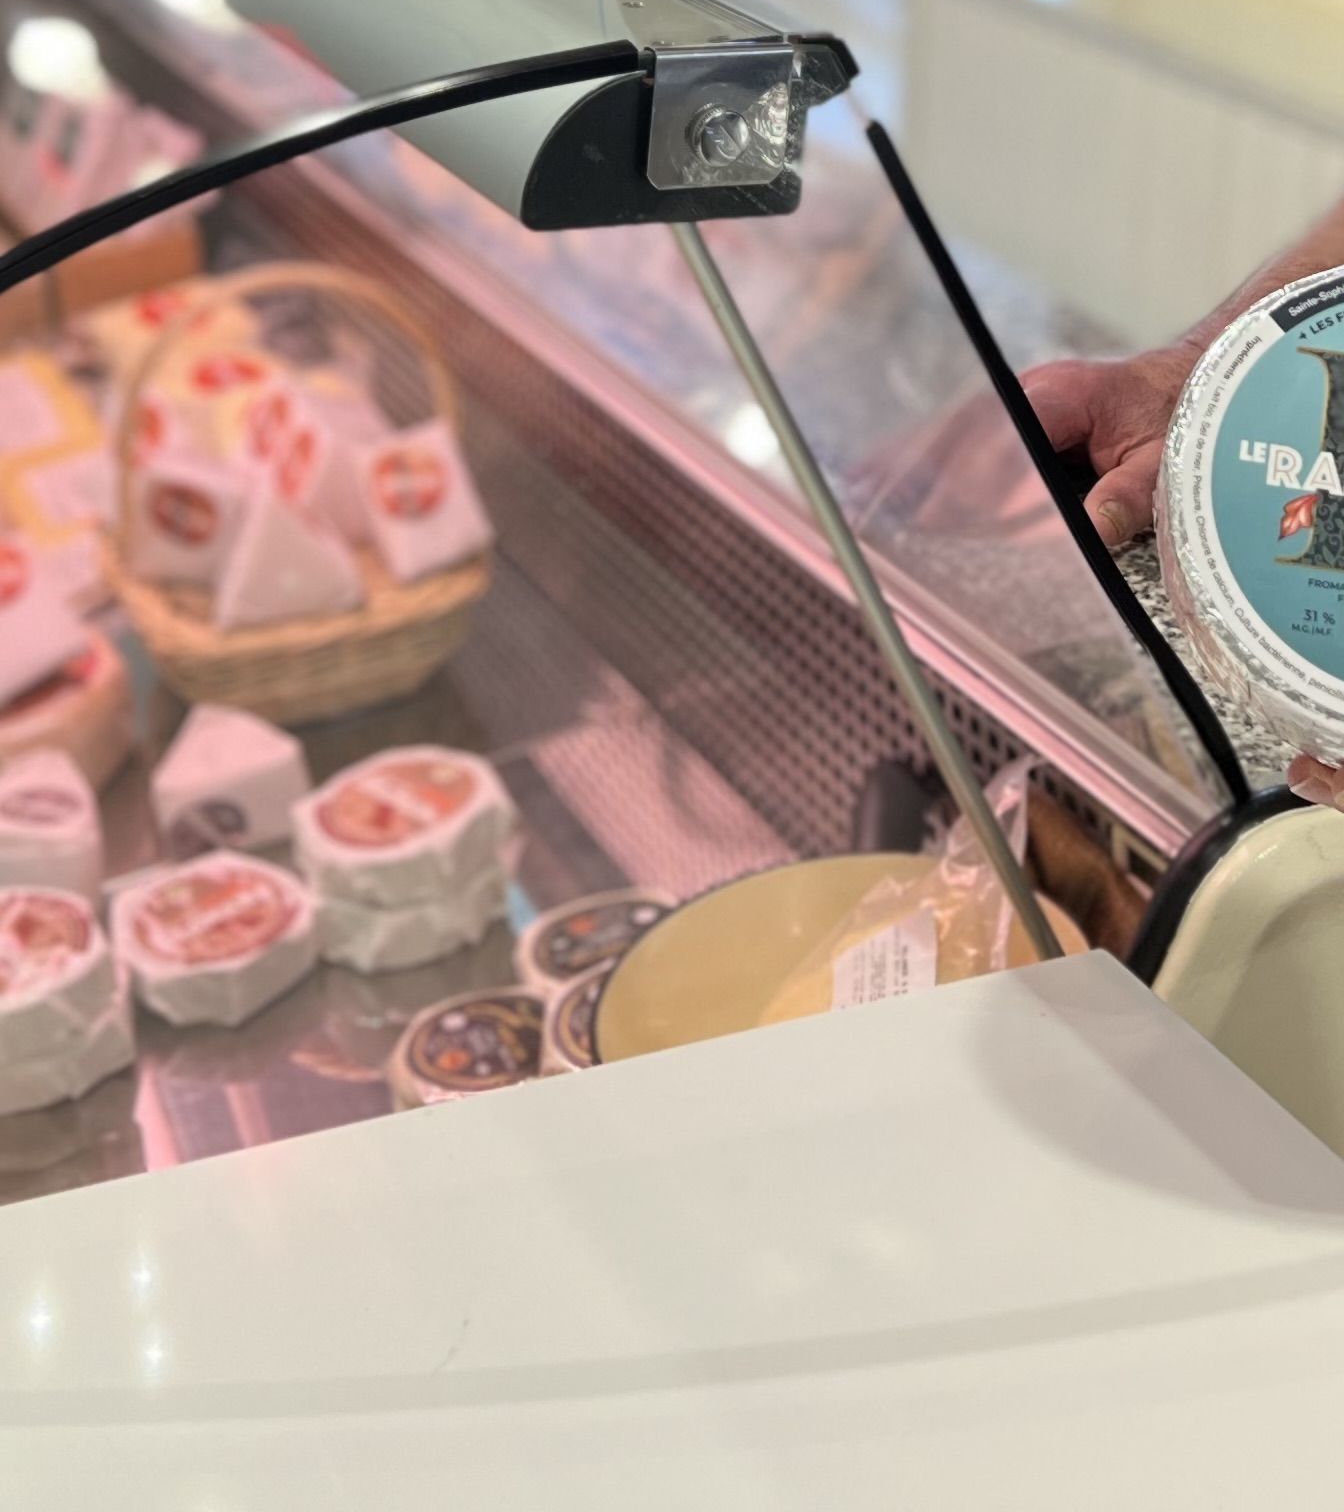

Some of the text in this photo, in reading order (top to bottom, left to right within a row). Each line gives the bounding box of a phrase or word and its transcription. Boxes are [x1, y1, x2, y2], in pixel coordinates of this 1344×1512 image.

[1309, 316, 1335, 335] LES
[1239, 439, 1268, 464] LE
[1303, 608, 1336, 626] 31 %
